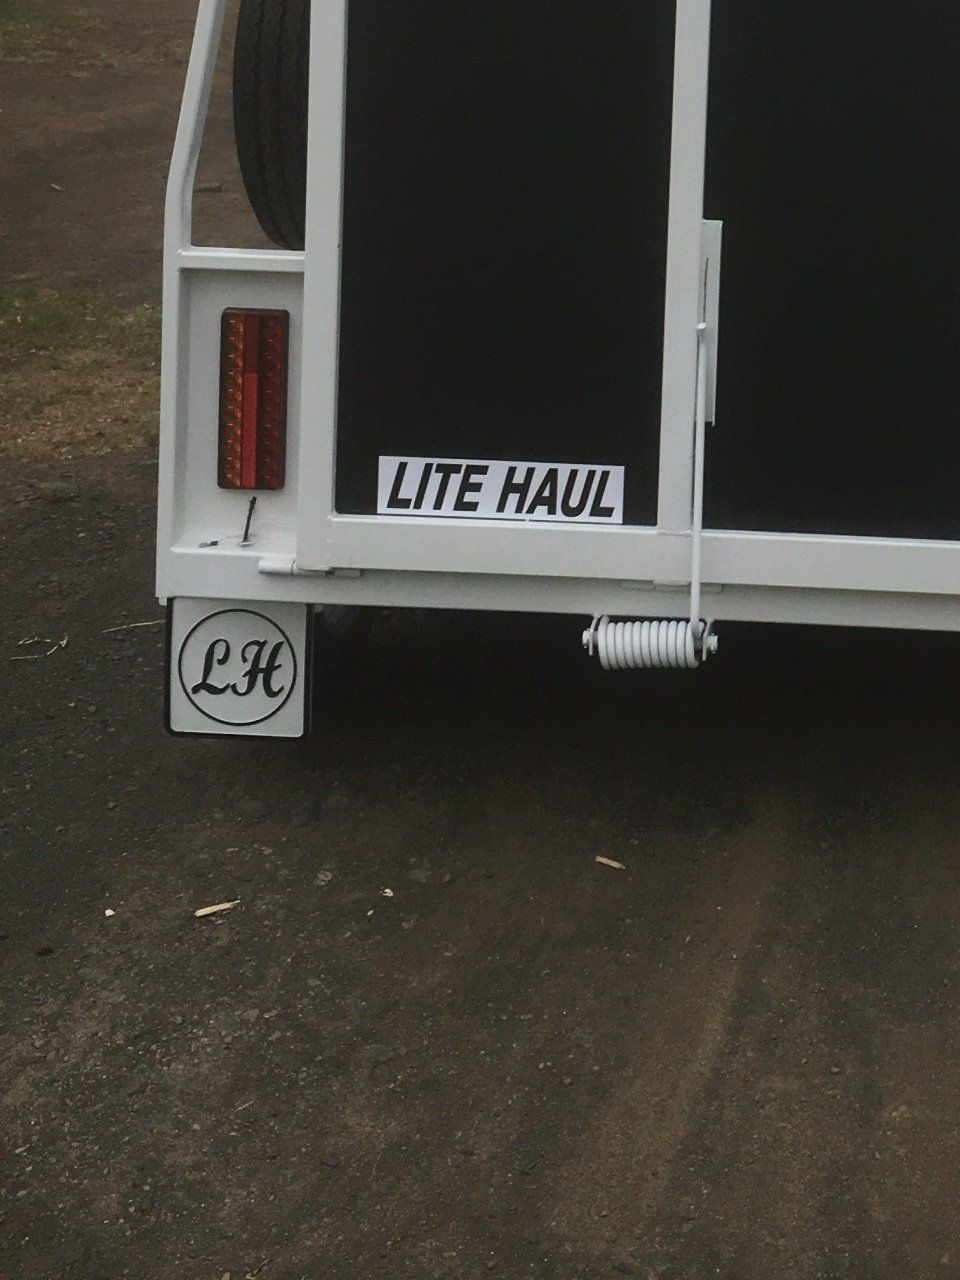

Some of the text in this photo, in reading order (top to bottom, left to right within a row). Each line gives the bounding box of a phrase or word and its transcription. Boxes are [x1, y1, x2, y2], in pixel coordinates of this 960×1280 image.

[386, 461, 615, 518] LITE HAUL
[191, 638, 285, 698] LH
